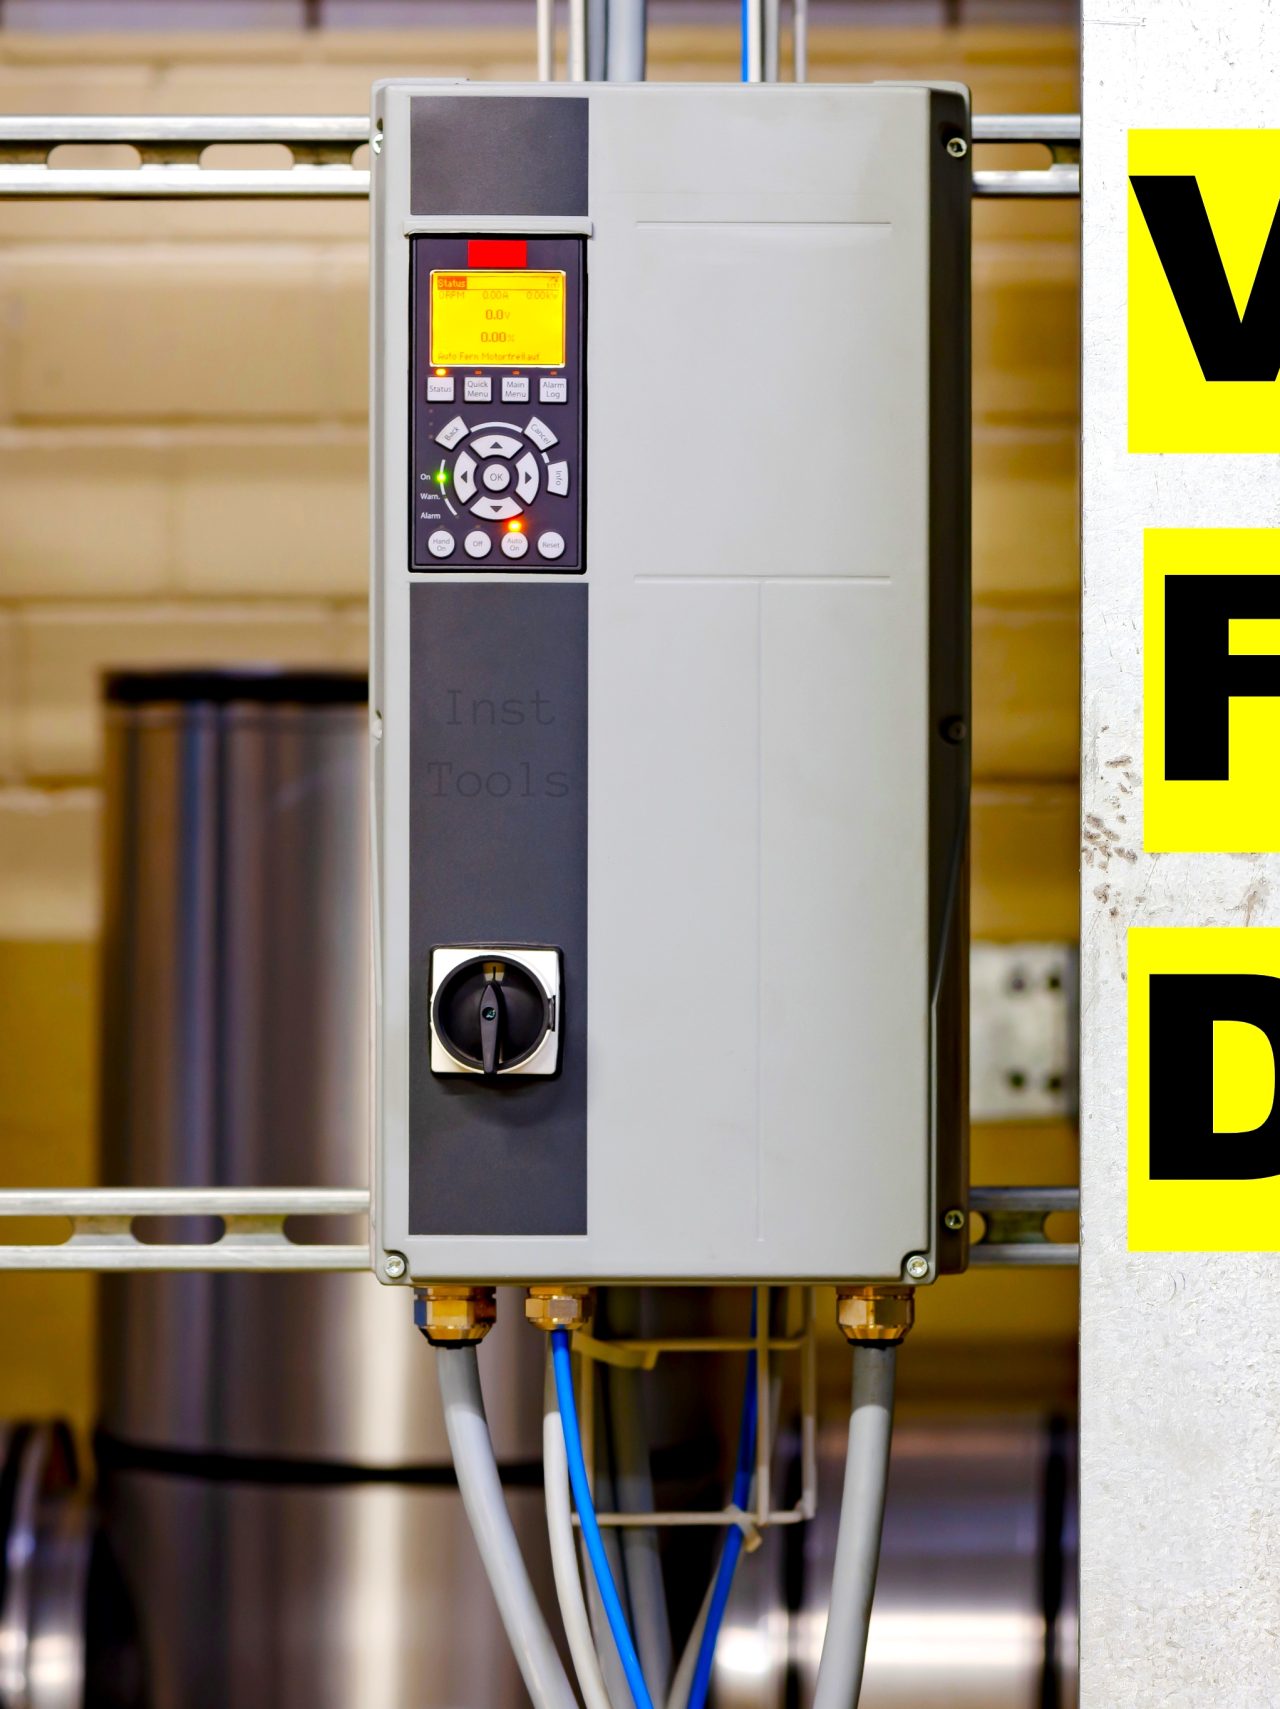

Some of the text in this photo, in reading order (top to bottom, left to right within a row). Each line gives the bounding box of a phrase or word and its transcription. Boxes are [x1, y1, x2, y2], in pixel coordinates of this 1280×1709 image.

[438, 276, 466, 288] Status
[467, 380, 488, 389] Quick
[542, 381, 565, 389] Alarm
[429, 385, 452, 393] Status
[546, 391, 560, 399] Log
[444, 426, 460, 441] Back
[530, 424, 551, 445] Cancel
[489, 473, 503, 482] OK
[420, 512, 441, 520] Alarm
[542, 541, 560, 549] Reset
